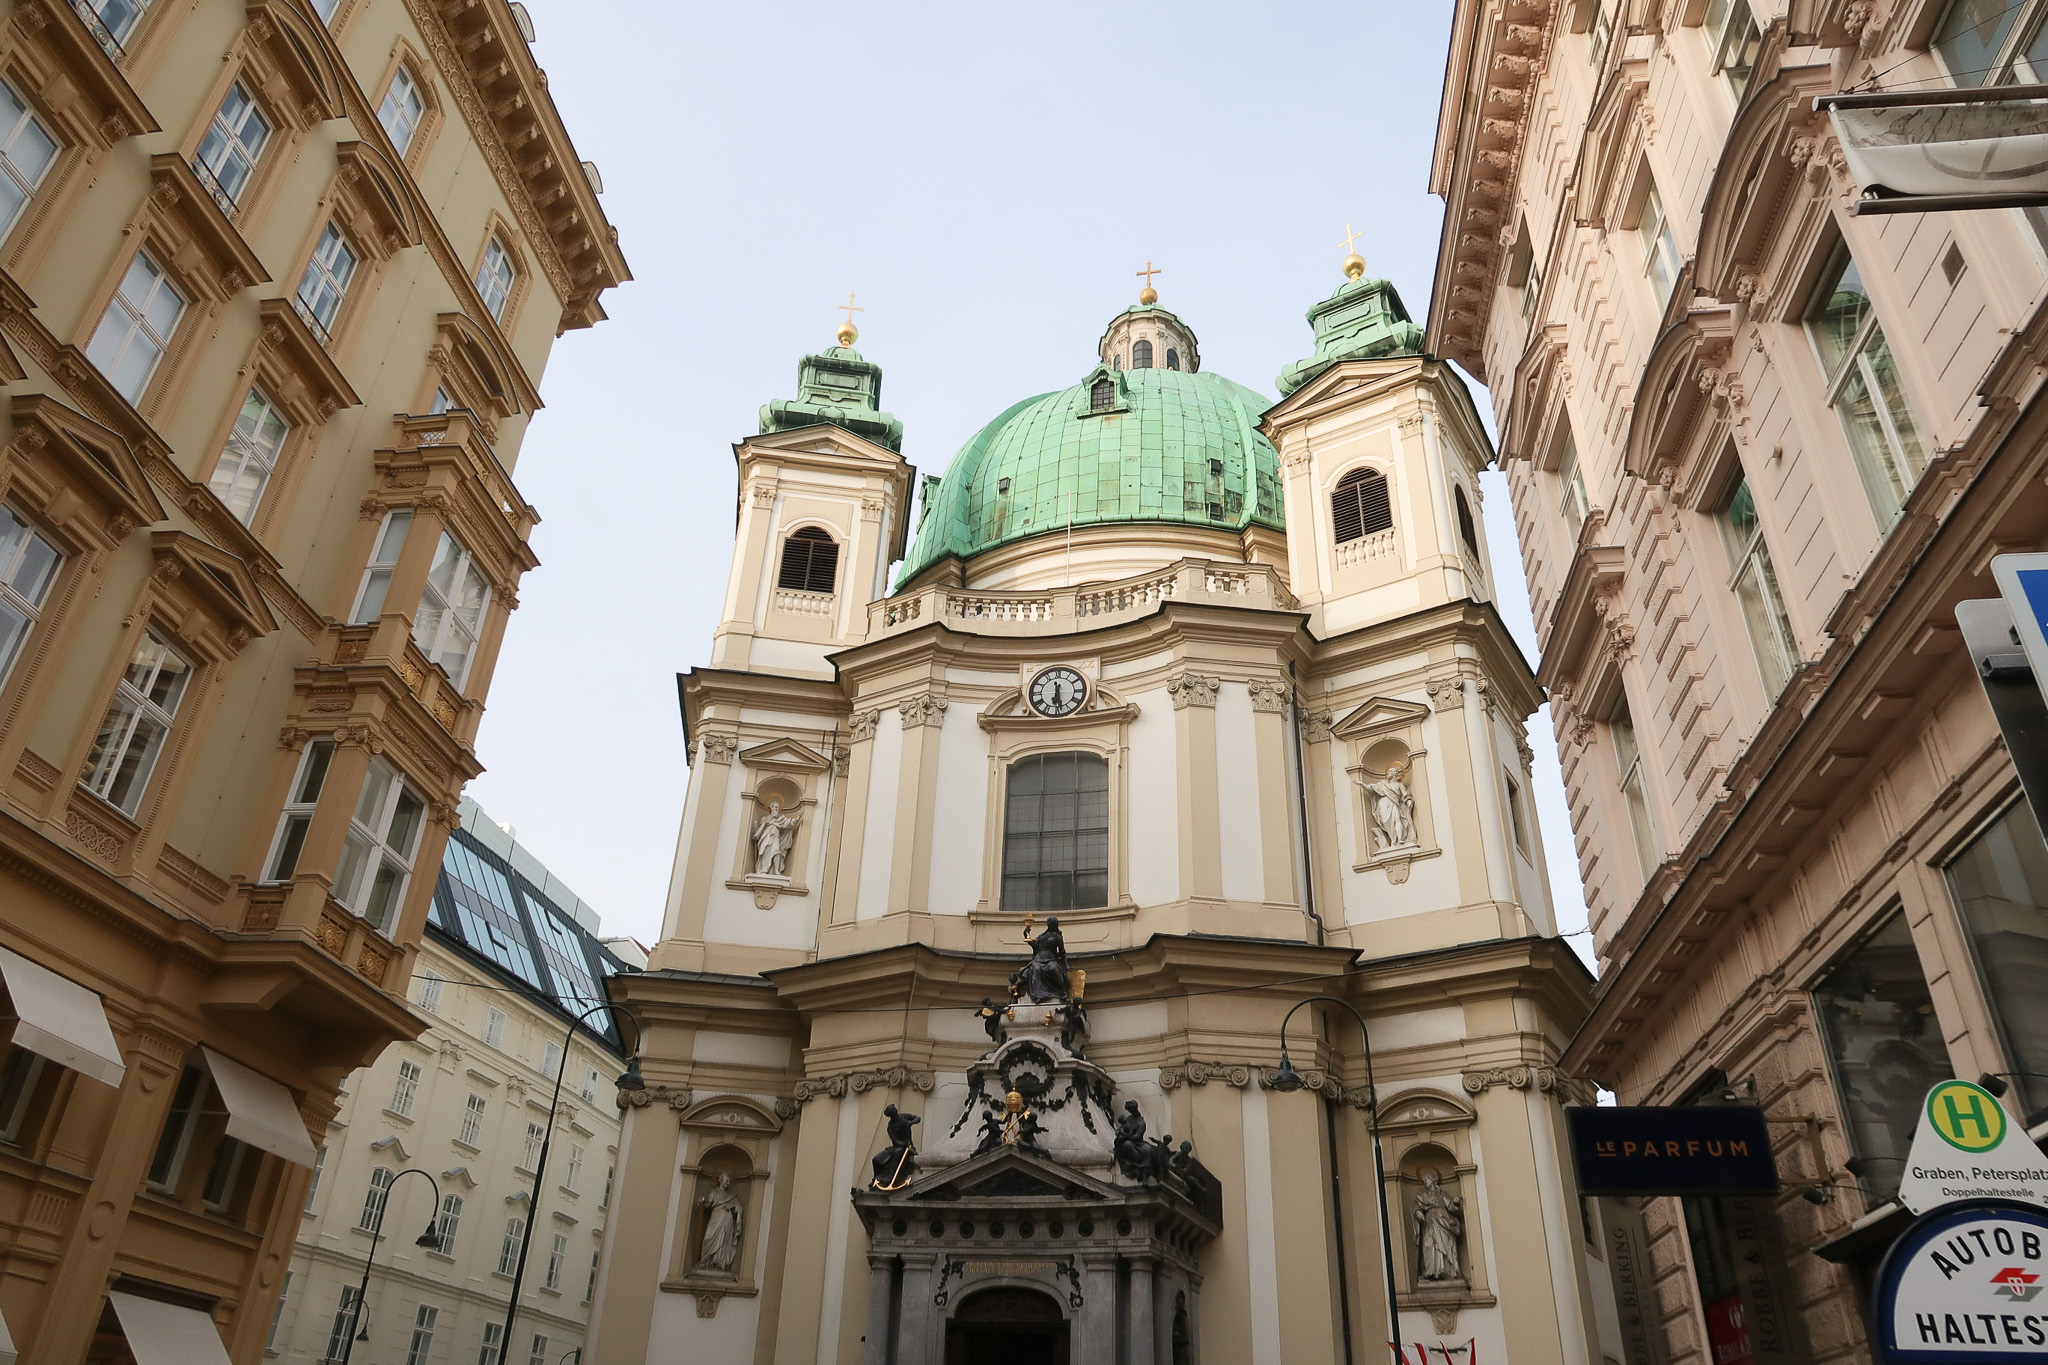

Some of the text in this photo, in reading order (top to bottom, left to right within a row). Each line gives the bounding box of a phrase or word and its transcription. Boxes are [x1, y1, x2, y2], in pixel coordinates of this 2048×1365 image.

[1943, 1095, 1991, 1138] H
[1596, 1140, 1749, 1157] LE PARFUM
[1912, 1166, 1970, 1182] Graben,
[1942, 1187, 2035, 1199] Doppelhaltestelle
[1612, 1227, 1638, 1308] BERKING
[1750, 1272, 1783, 1354] ROBBE
